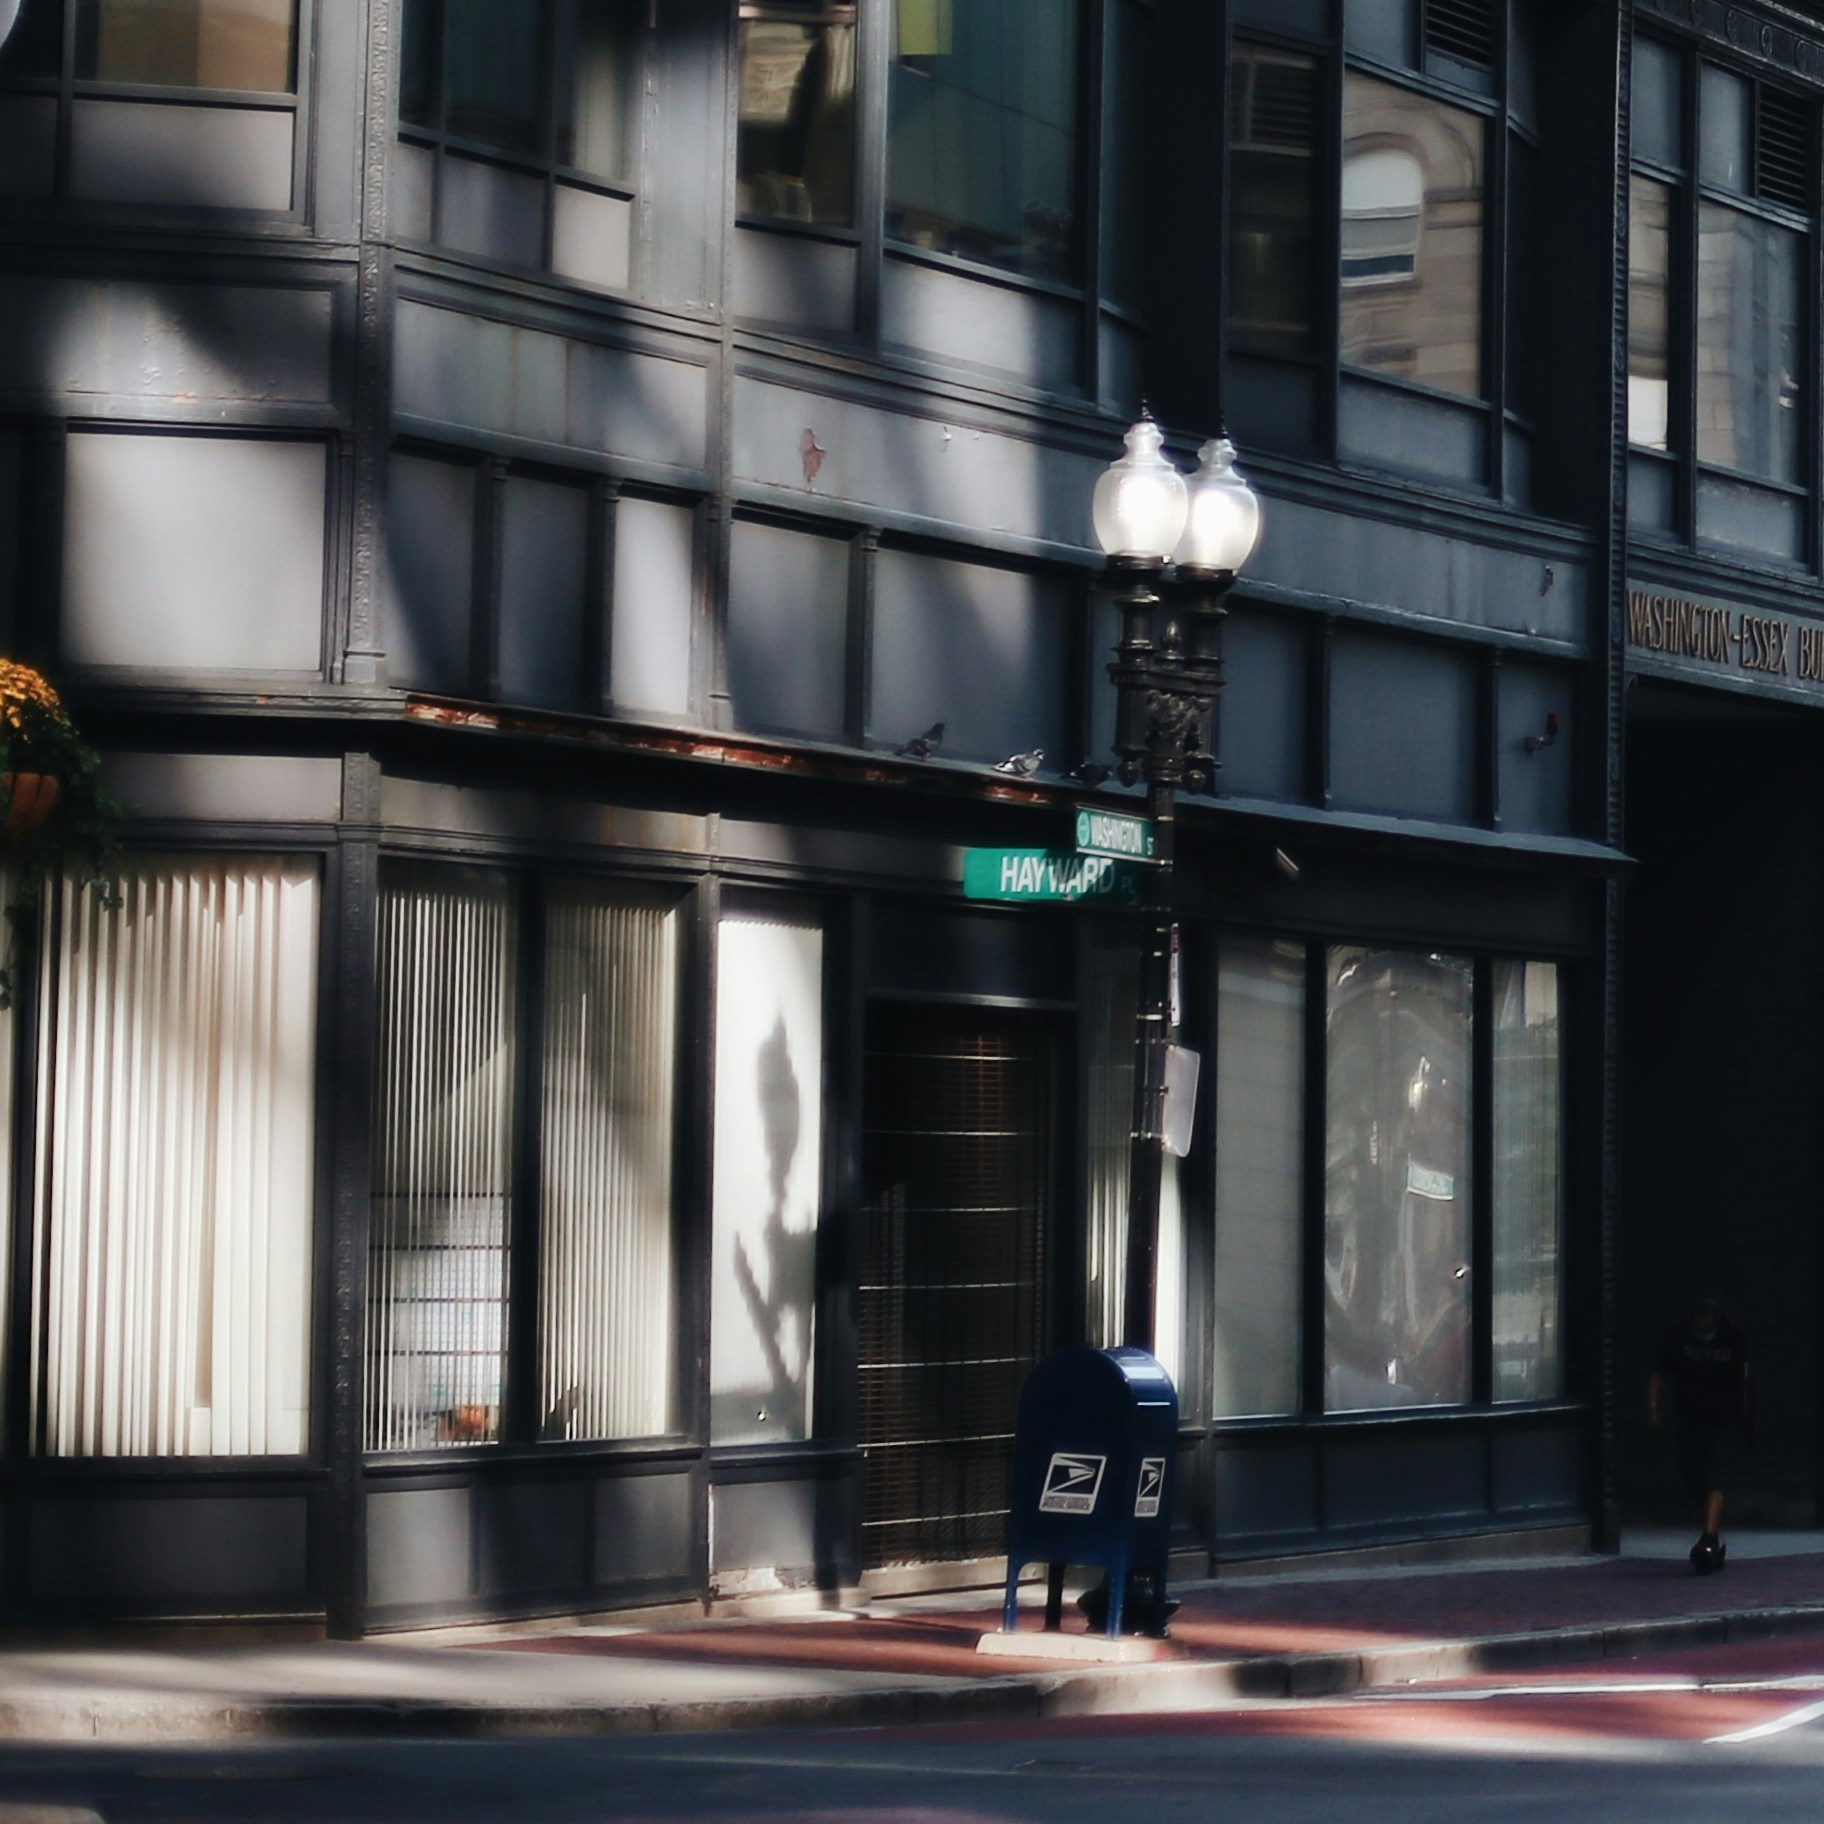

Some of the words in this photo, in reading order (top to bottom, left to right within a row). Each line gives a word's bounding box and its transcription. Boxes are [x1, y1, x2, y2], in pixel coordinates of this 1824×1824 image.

[1627, 590, 1789, 675] WASHINGTON-ESSEX
[1090, 815, 1143, 854] WASHINGTON
[1000, 856, 1115, 894] HAYWARD
